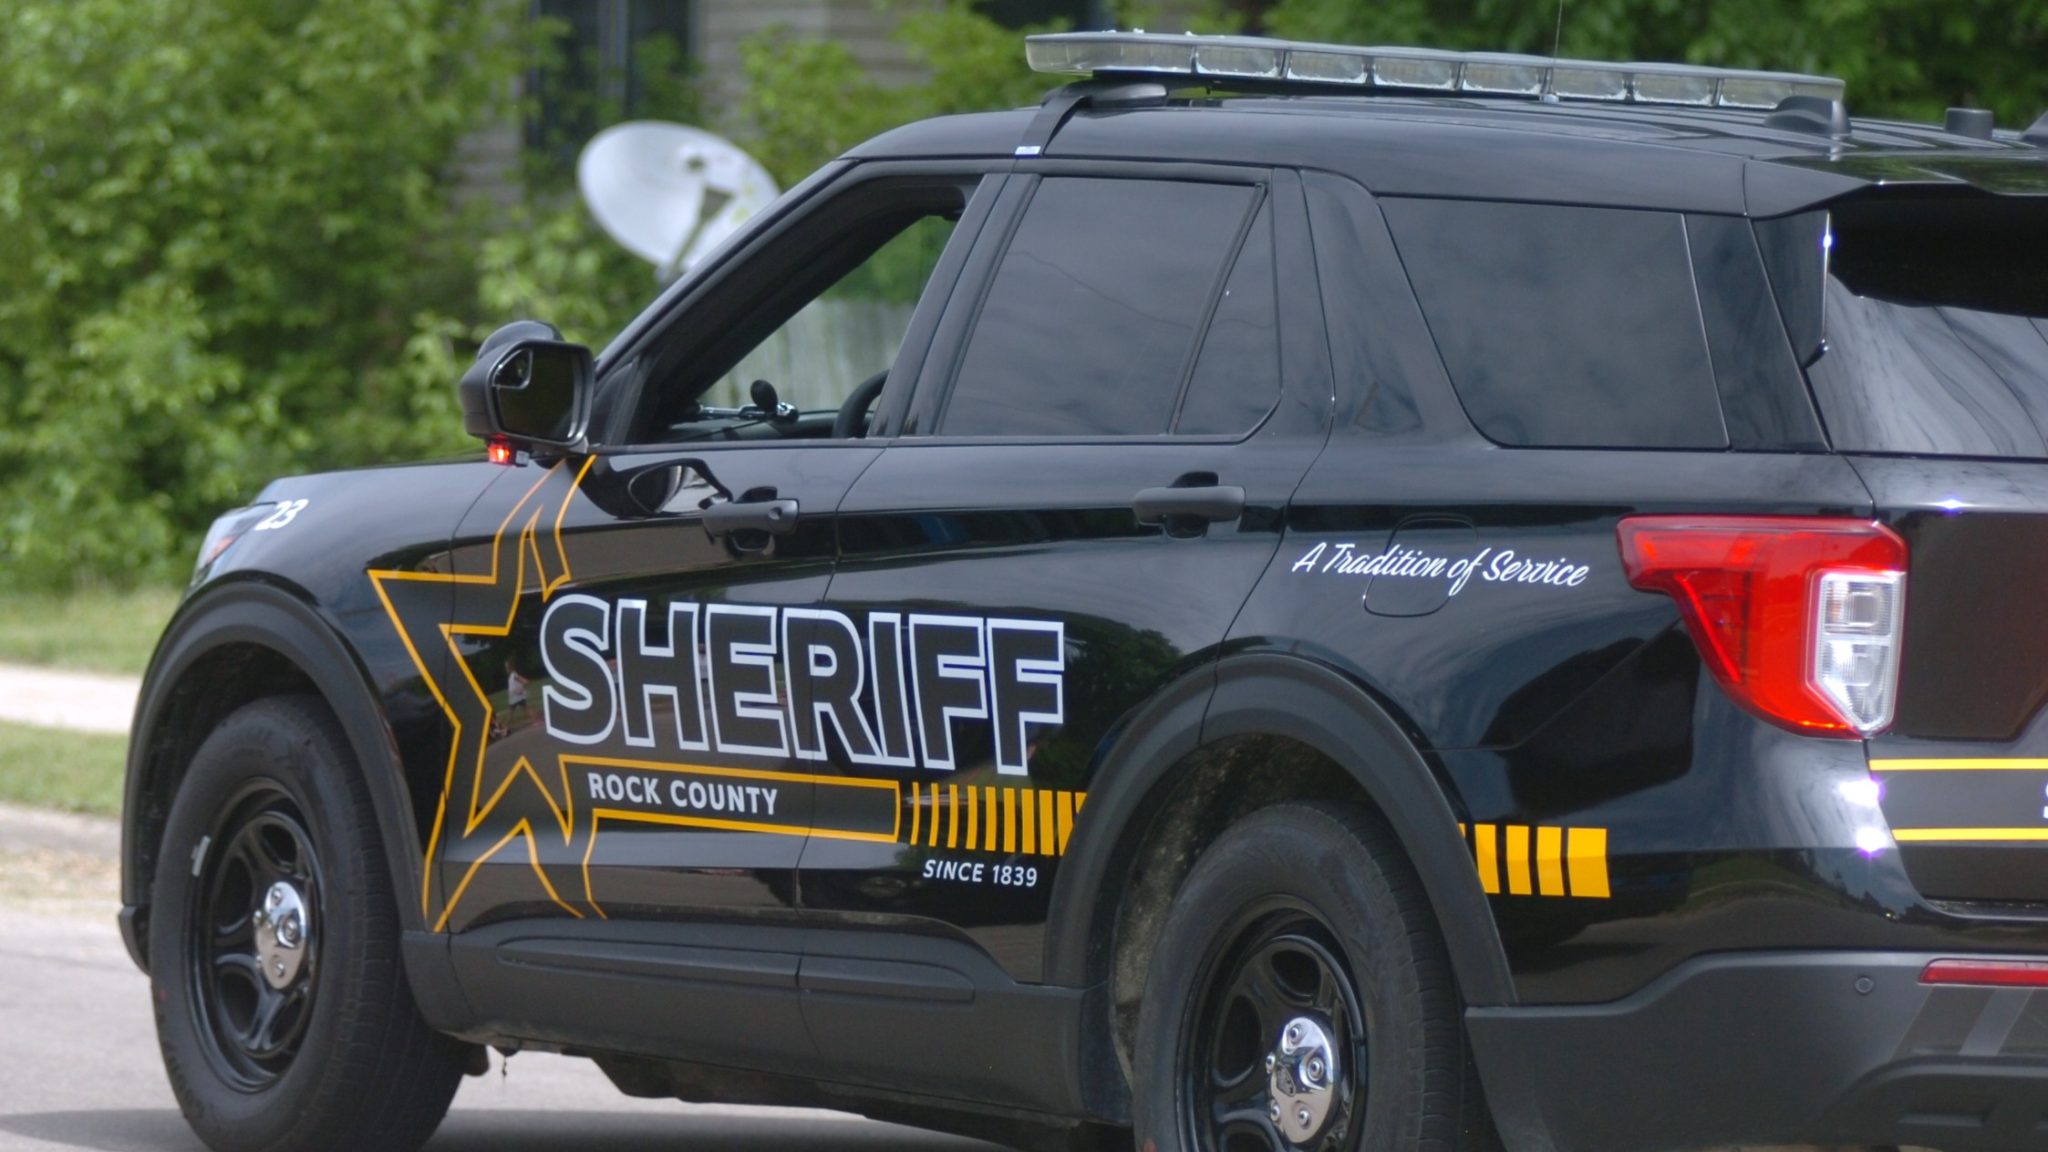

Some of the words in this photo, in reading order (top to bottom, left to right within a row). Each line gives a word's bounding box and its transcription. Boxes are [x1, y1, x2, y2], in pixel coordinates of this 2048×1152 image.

[254, 498, 309, 531] 23
[1292, 542, 1327, 573] A
[1322, 543, 1447, 578] Tradition
[1447, 547, 1491, 597] of
[1482, 550, 1590, 587] Service
[539, 594, 1065, 776] SHERIFF
[587, 772, 662, 805] ROCK
[669, 779, 778, 815] COUNTY
[922, 859, 985, 883] SINCE
[992, 864, 1038, 887] 1839
